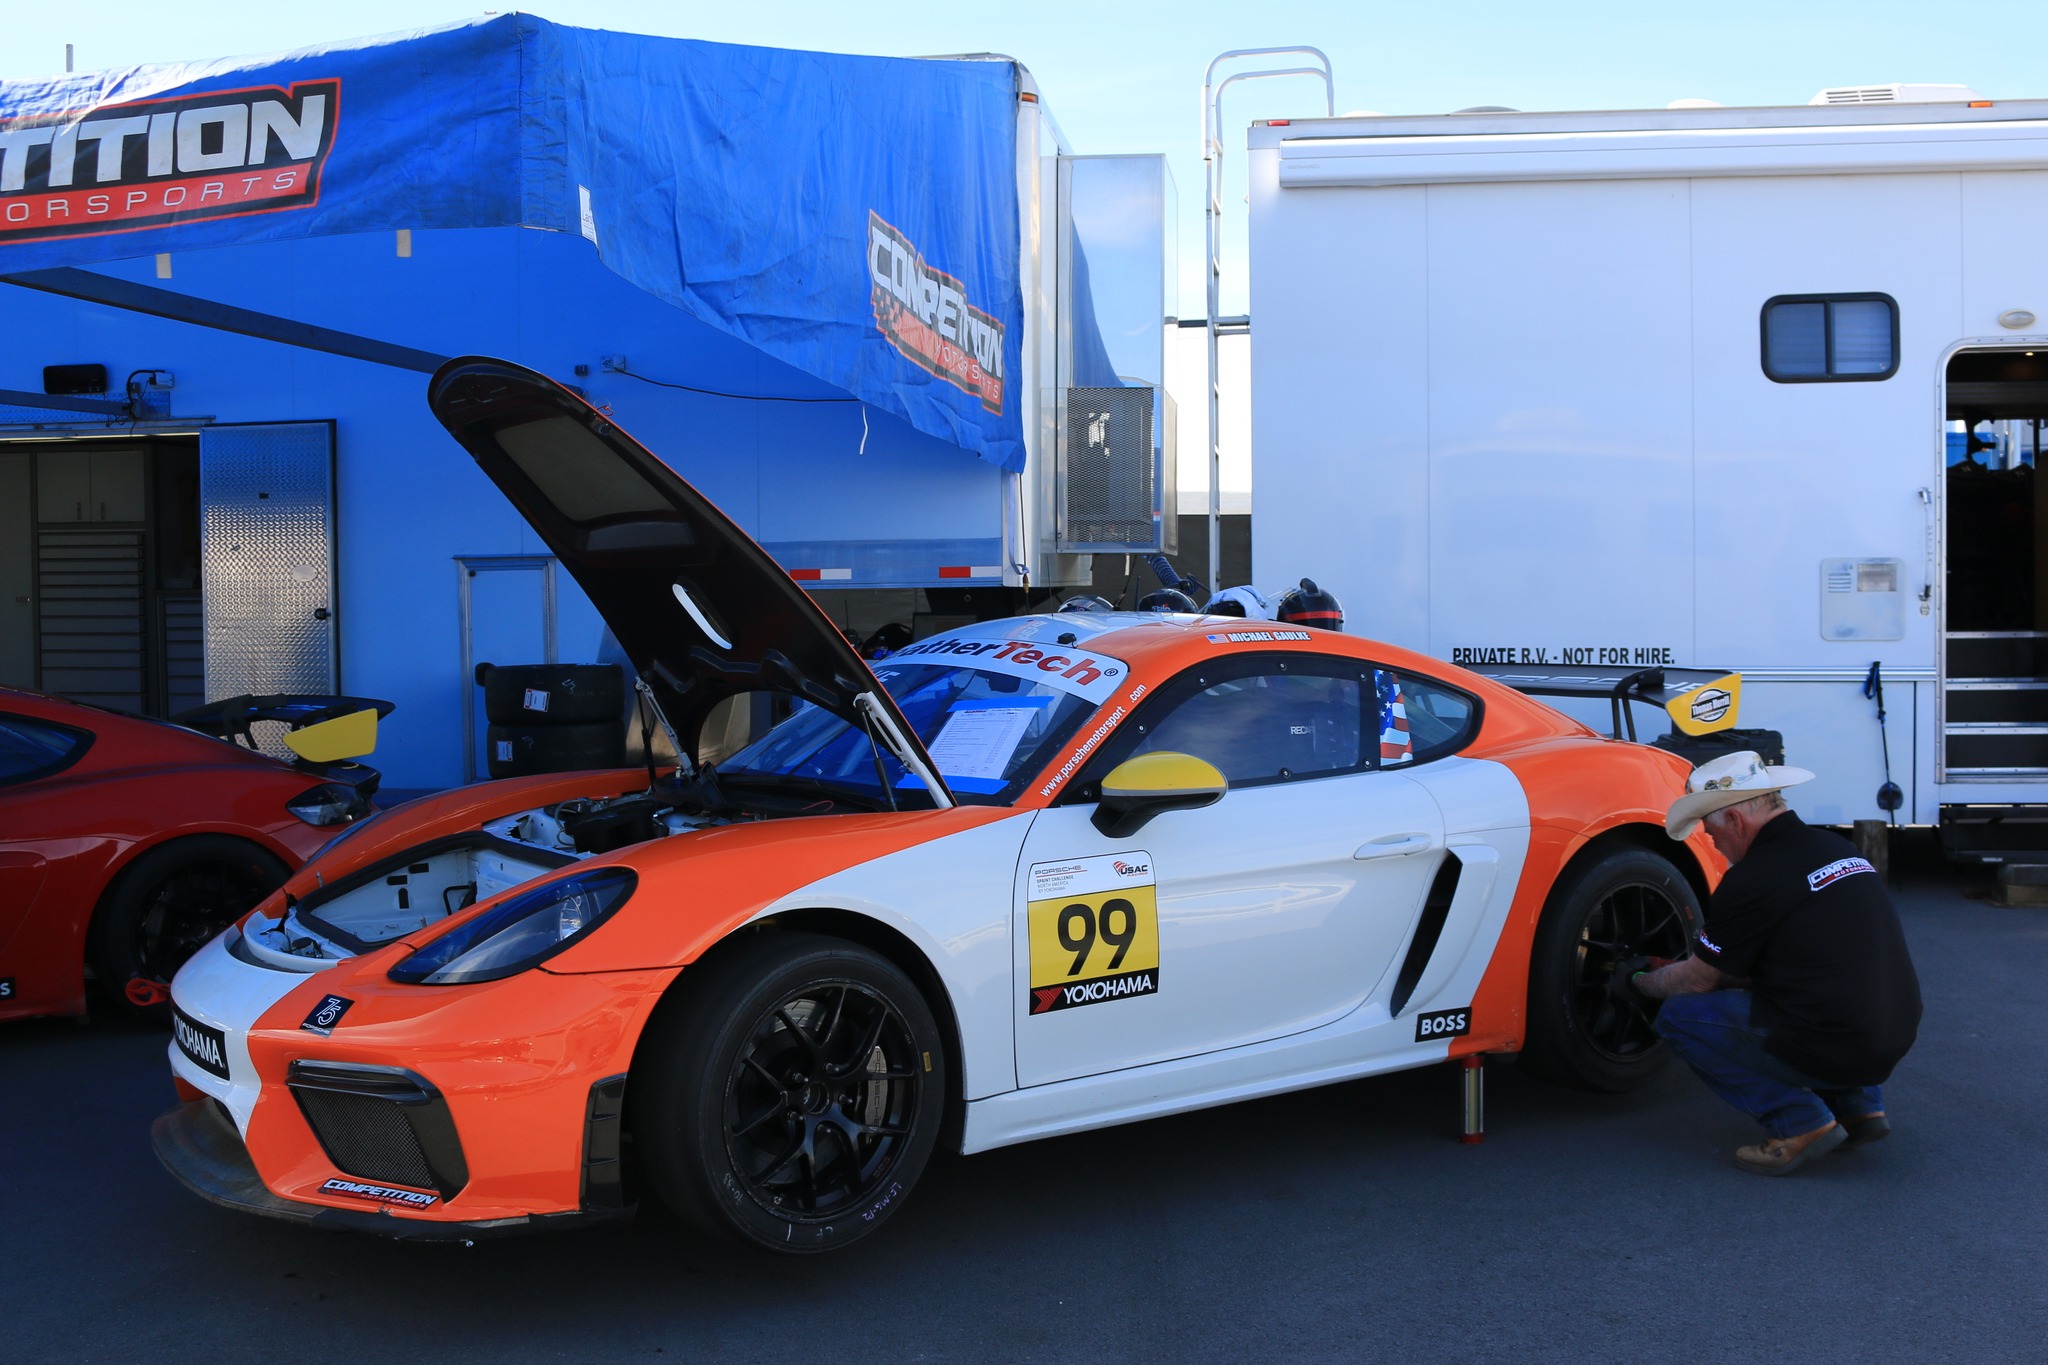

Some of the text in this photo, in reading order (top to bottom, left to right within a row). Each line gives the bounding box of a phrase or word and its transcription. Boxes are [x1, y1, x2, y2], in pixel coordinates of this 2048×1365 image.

[7, 171, 297, 222] ORSPORTS
[1228, 630, 1311, 642] MICHAEL GAULKE
[1453, 648, 1516, 664] PRIVATE
[1521, 648, 1549, 664] R.V.
[1563, 648, 1594, 664] NOT
[1600, 648, 1629, 664] FOR
[1634, 648, 1675, 664] HIRE.
[1034, 865, 1082, 875] PORSCHE
[1120, 864, 1148, 874] USAC
[1057, 898, 1137, 976] 99
[1063, 974, 1152, 1004] YOKOHAMA
[1420, 1013, 1466, 1035] BOSS
[323, 1179, 438, 1205] COMPETITION
